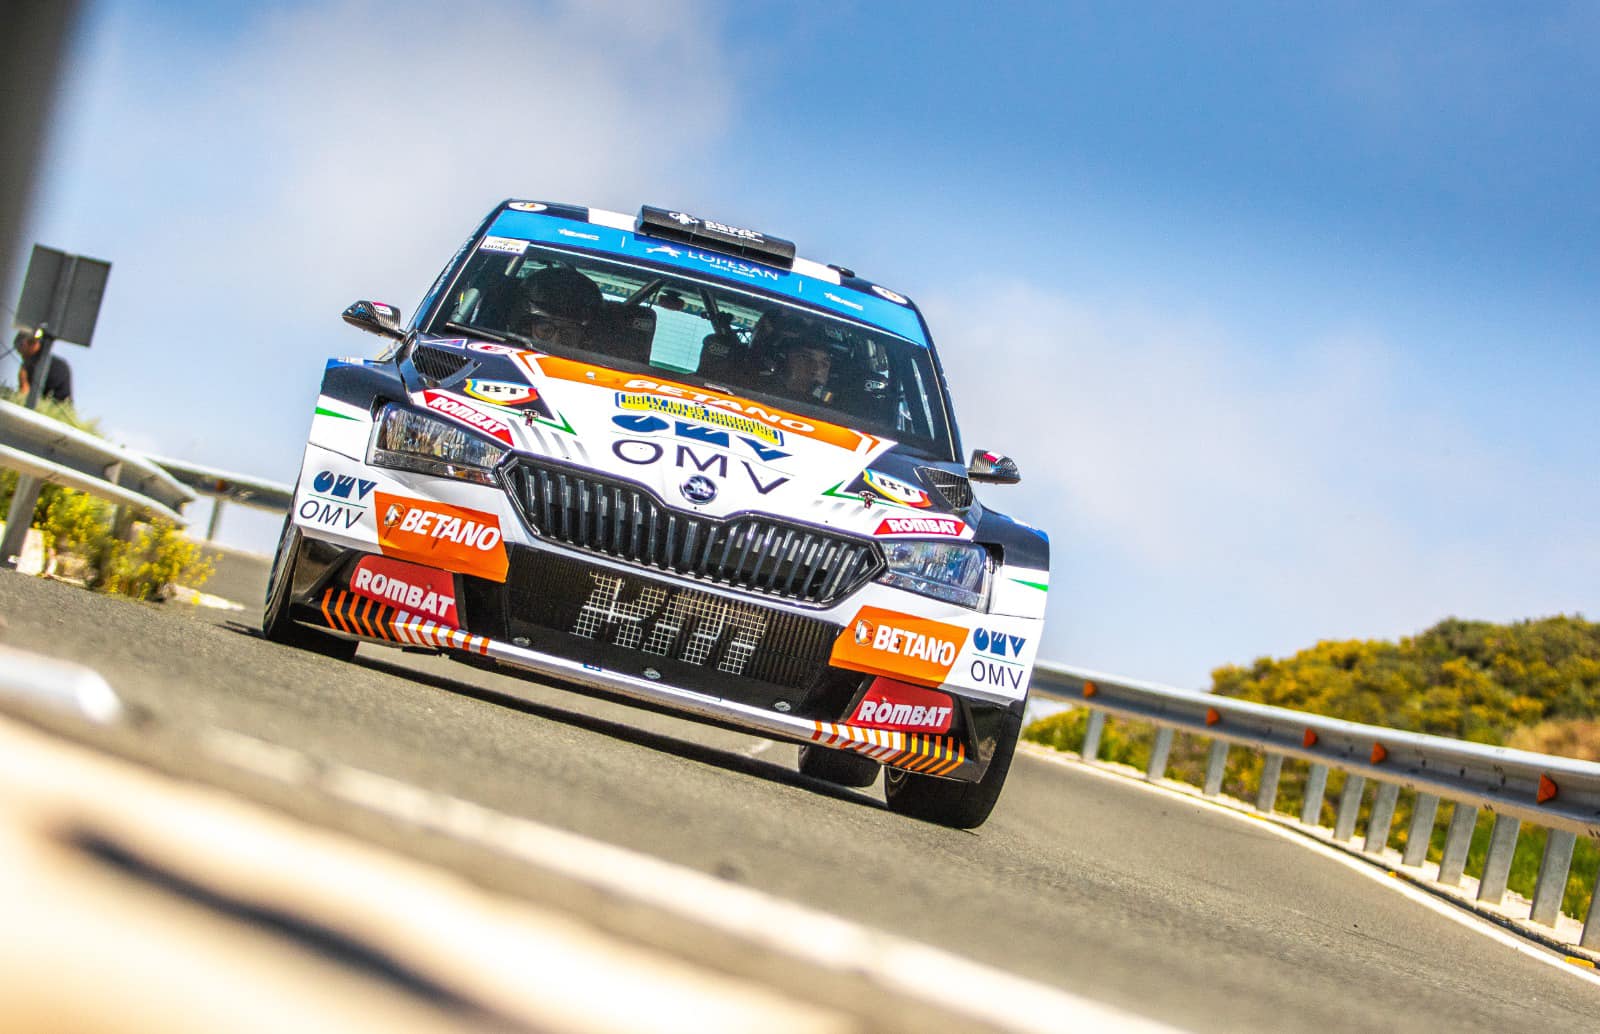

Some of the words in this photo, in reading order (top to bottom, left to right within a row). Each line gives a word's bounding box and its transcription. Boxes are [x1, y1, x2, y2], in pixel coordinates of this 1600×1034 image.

[687, 249, 778, 281] LOPESAN
[429, 397, 508, 434] ROMBAT
[623, 379, 816, 433] BETANO
[625, 395, 663, 408] RALLY
[611, 438, 791, 495] OMV
[299, 500, 365, 530] OMV
[399, 508, 501, 552] BETANO
[886, 519, 957, 535] ROMBAT
[354, 567, 456, 619] ROMBAT
[872, 624, 957, 667] BETANO
[970, 659, 1024, 690] OMV
[856, 700, 952, 728] ROMBAT
